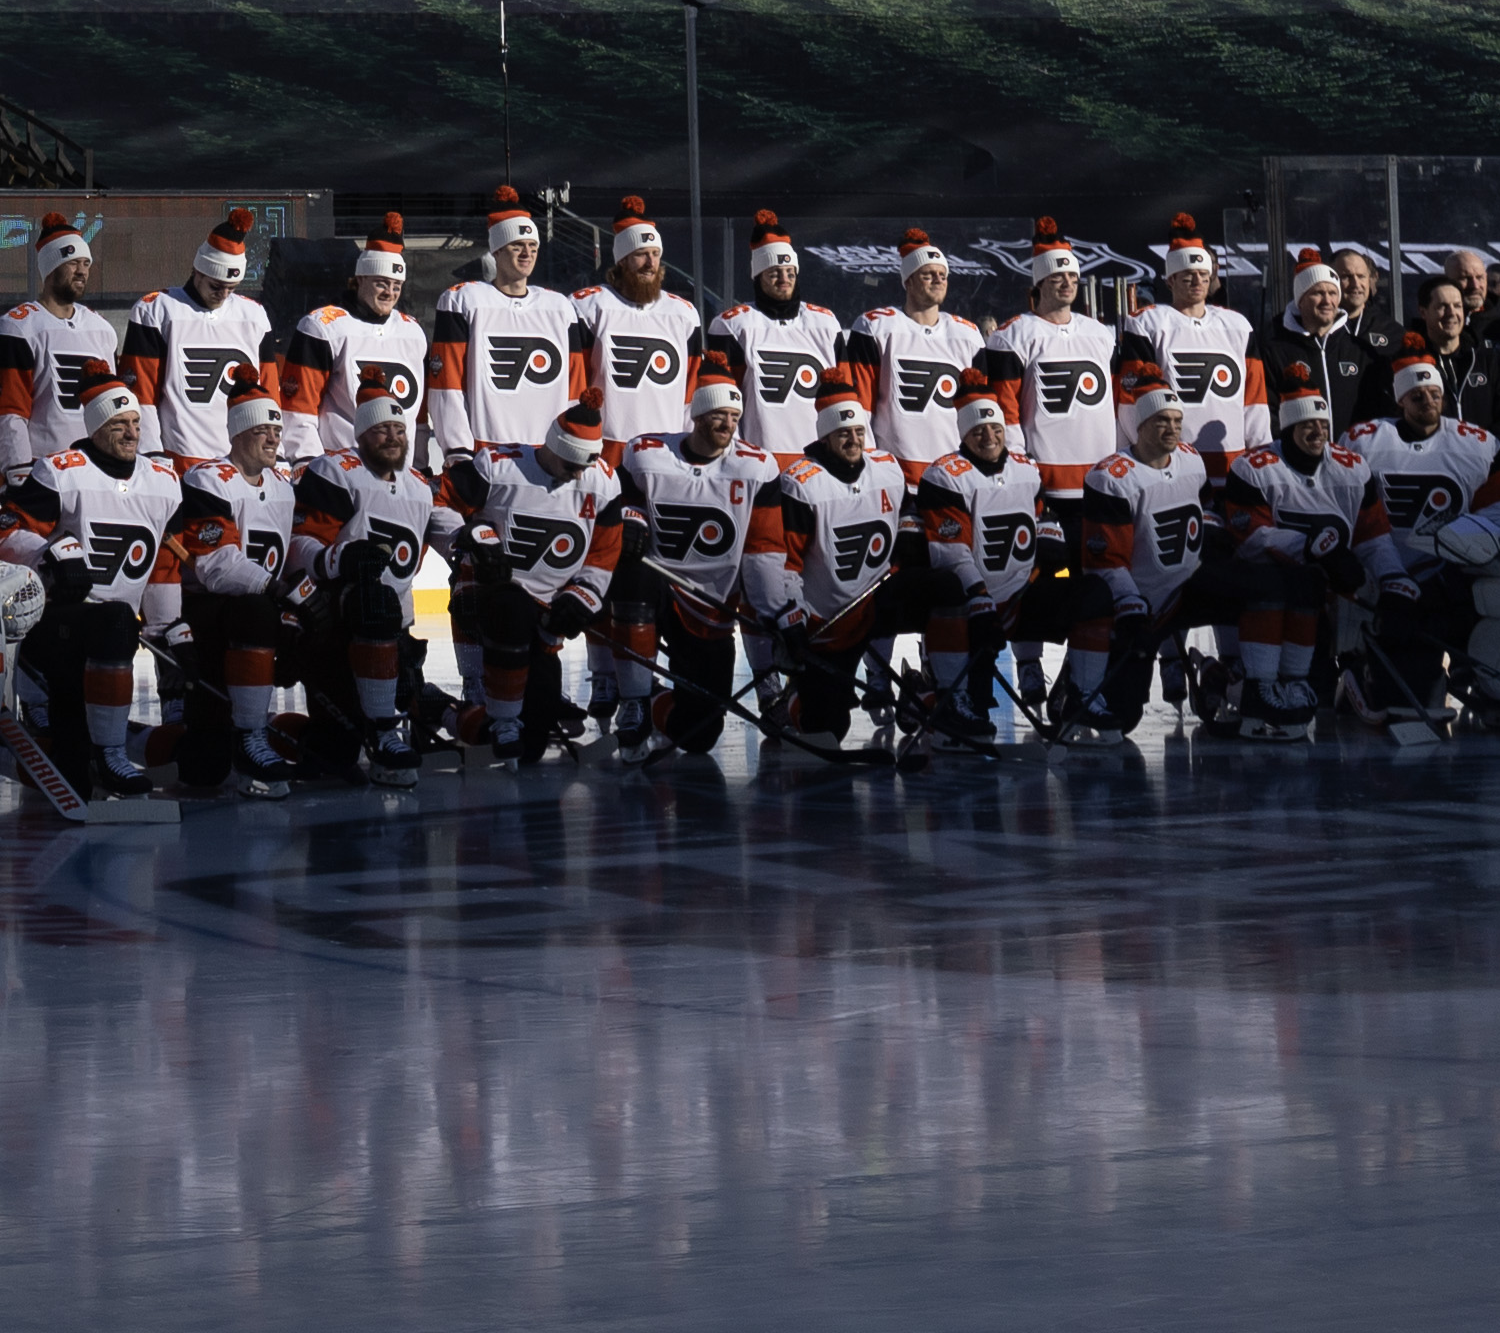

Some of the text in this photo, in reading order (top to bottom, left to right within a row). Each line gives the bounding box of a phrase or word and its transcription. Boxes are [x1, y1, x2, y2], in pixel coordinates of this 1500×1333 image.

[729, 479, 744, 505] C
[881, 489, 893, 514] A
[579, 493, 596, 520] A
[0, 717, 81, 812] WARRIOR
